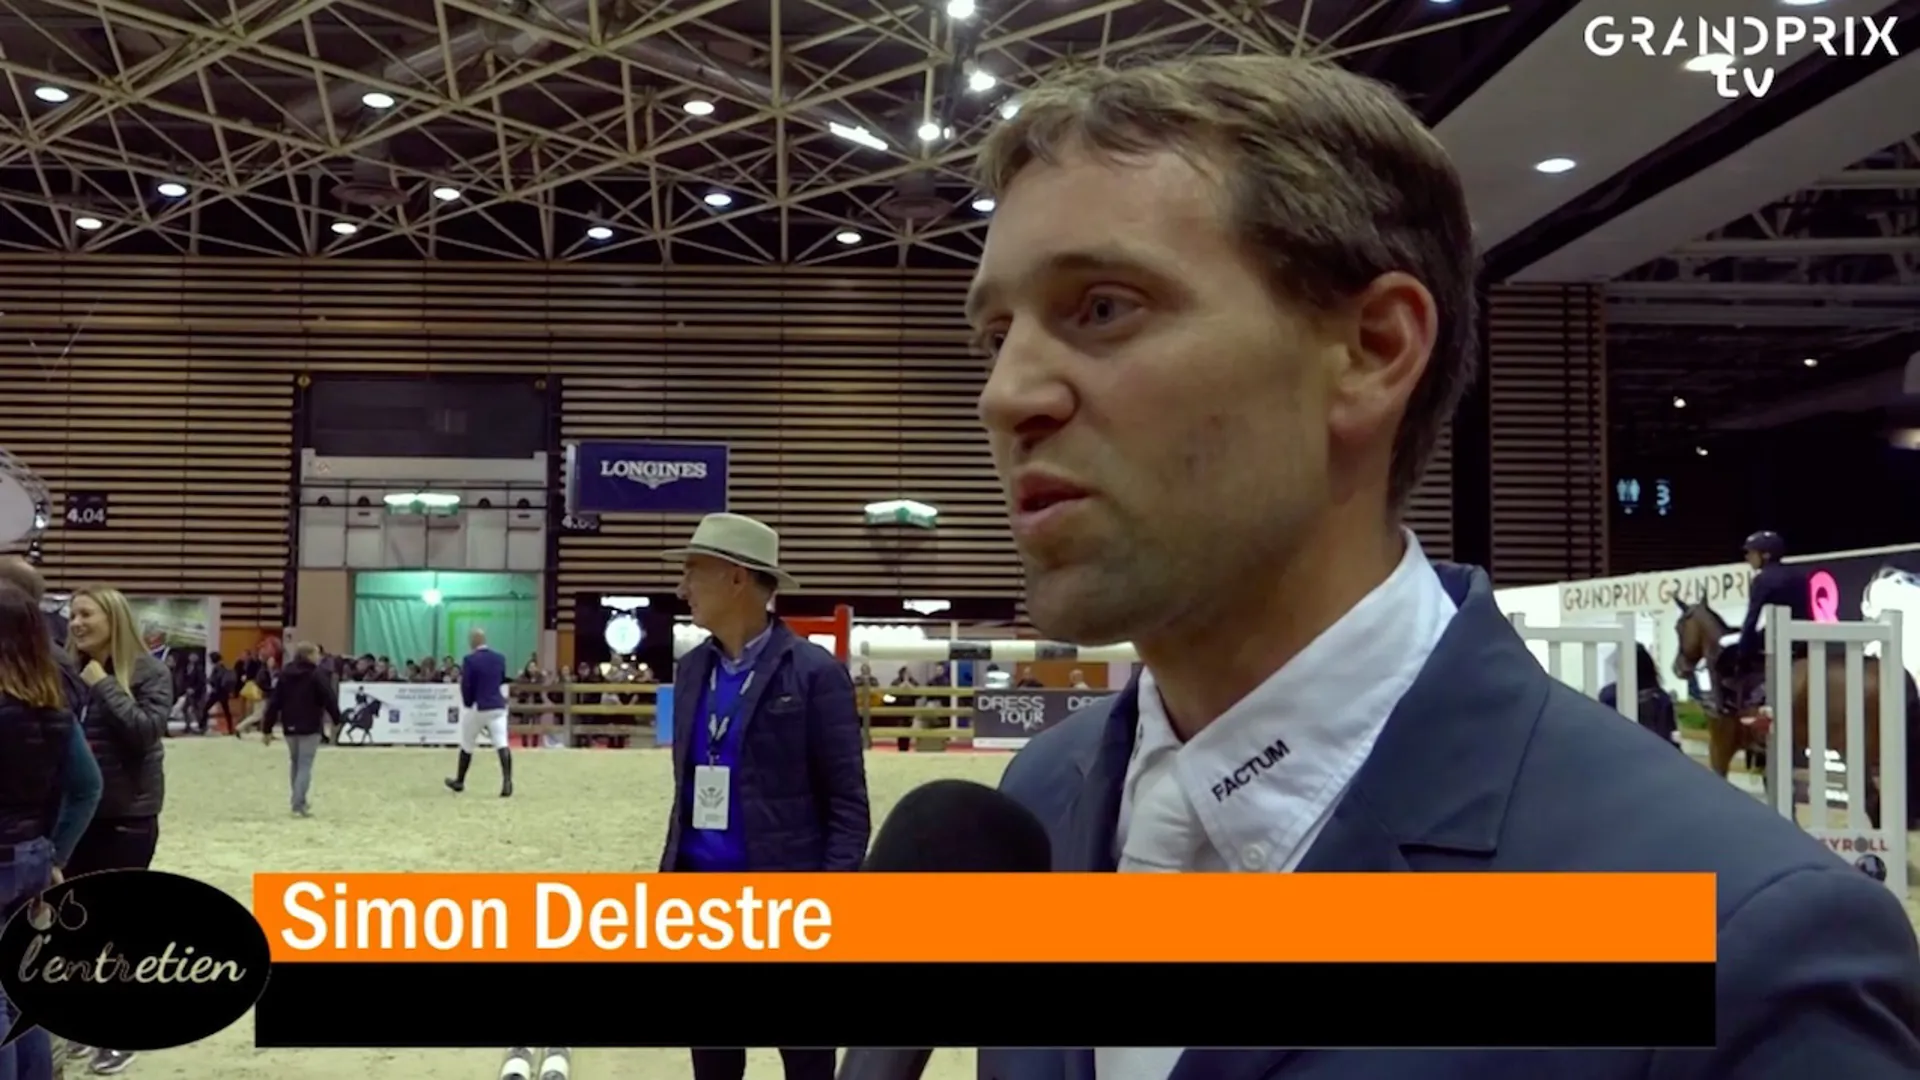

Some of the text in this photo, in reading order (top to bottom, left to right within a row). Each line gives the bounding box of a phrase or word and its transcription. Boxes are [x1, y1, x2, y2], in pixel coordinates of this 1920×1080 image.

[600, 459, 708, 479] LONGINES
[66, 507, 106, 523] 4.04
[1564, 570, 1751, 610] GRANDPRIX GRANDPRI
[978, 695, 1045, 711] DRESS
[998, 710, 1045, 724] TOUR
[1210, 738, 1291, 803] FACTUM
